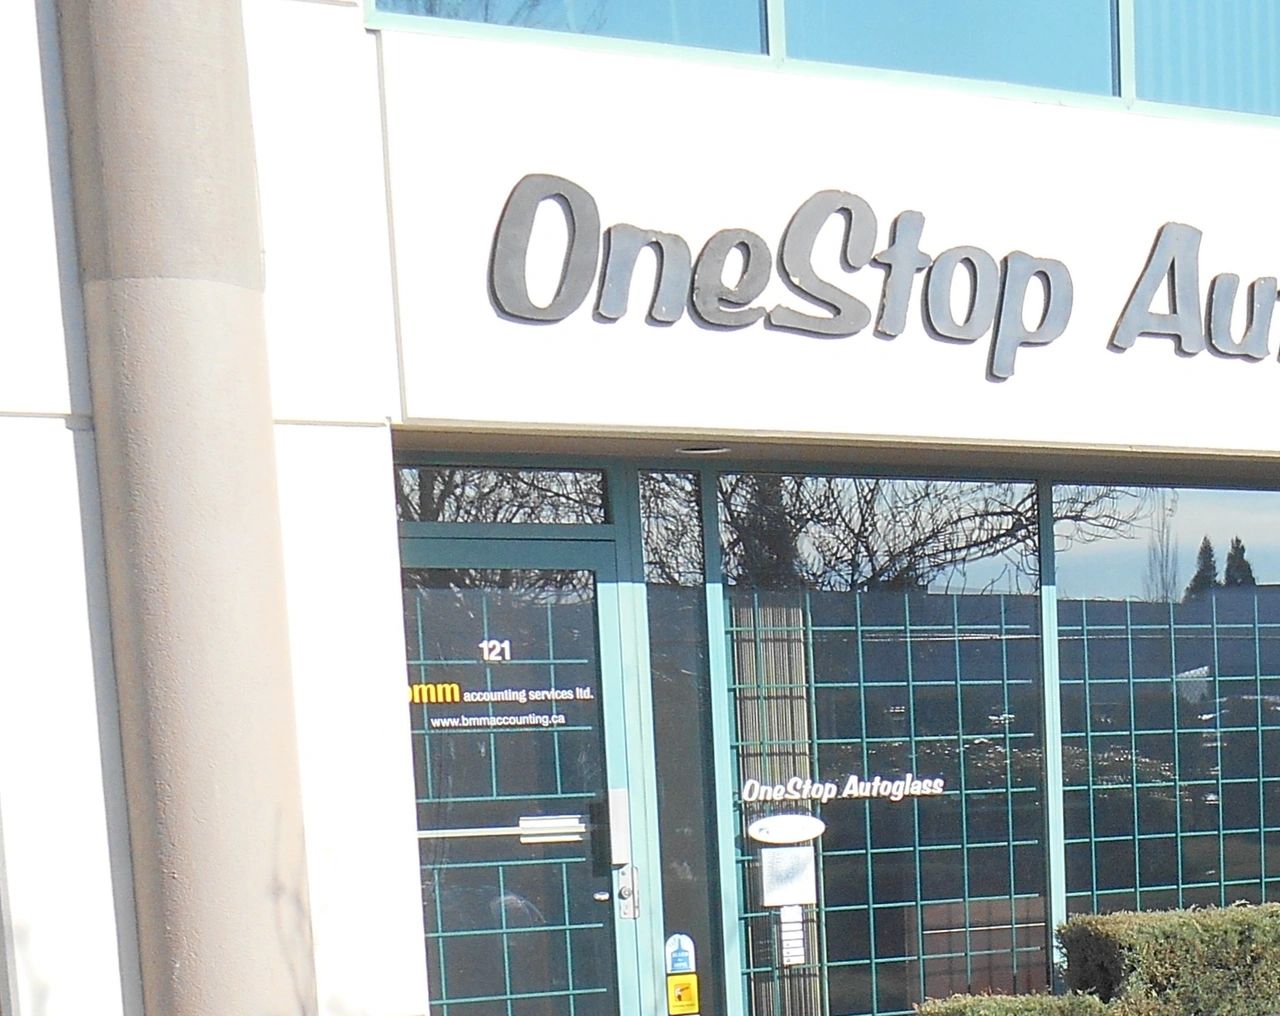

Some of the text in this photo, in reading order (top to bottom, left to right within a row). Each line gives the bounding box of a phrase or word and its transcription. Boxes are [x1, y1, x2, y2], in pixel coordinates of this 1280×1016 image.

[488, 173, 1074, 382] OneStop
[479, 640, 511, 661] 121
[408, 682, 595, 703] mm accounting services ltd.
[430, 713, 566, 728] www.bmmaccounting.ca
[742, 773, 945, 803] OneStop Autoglass
